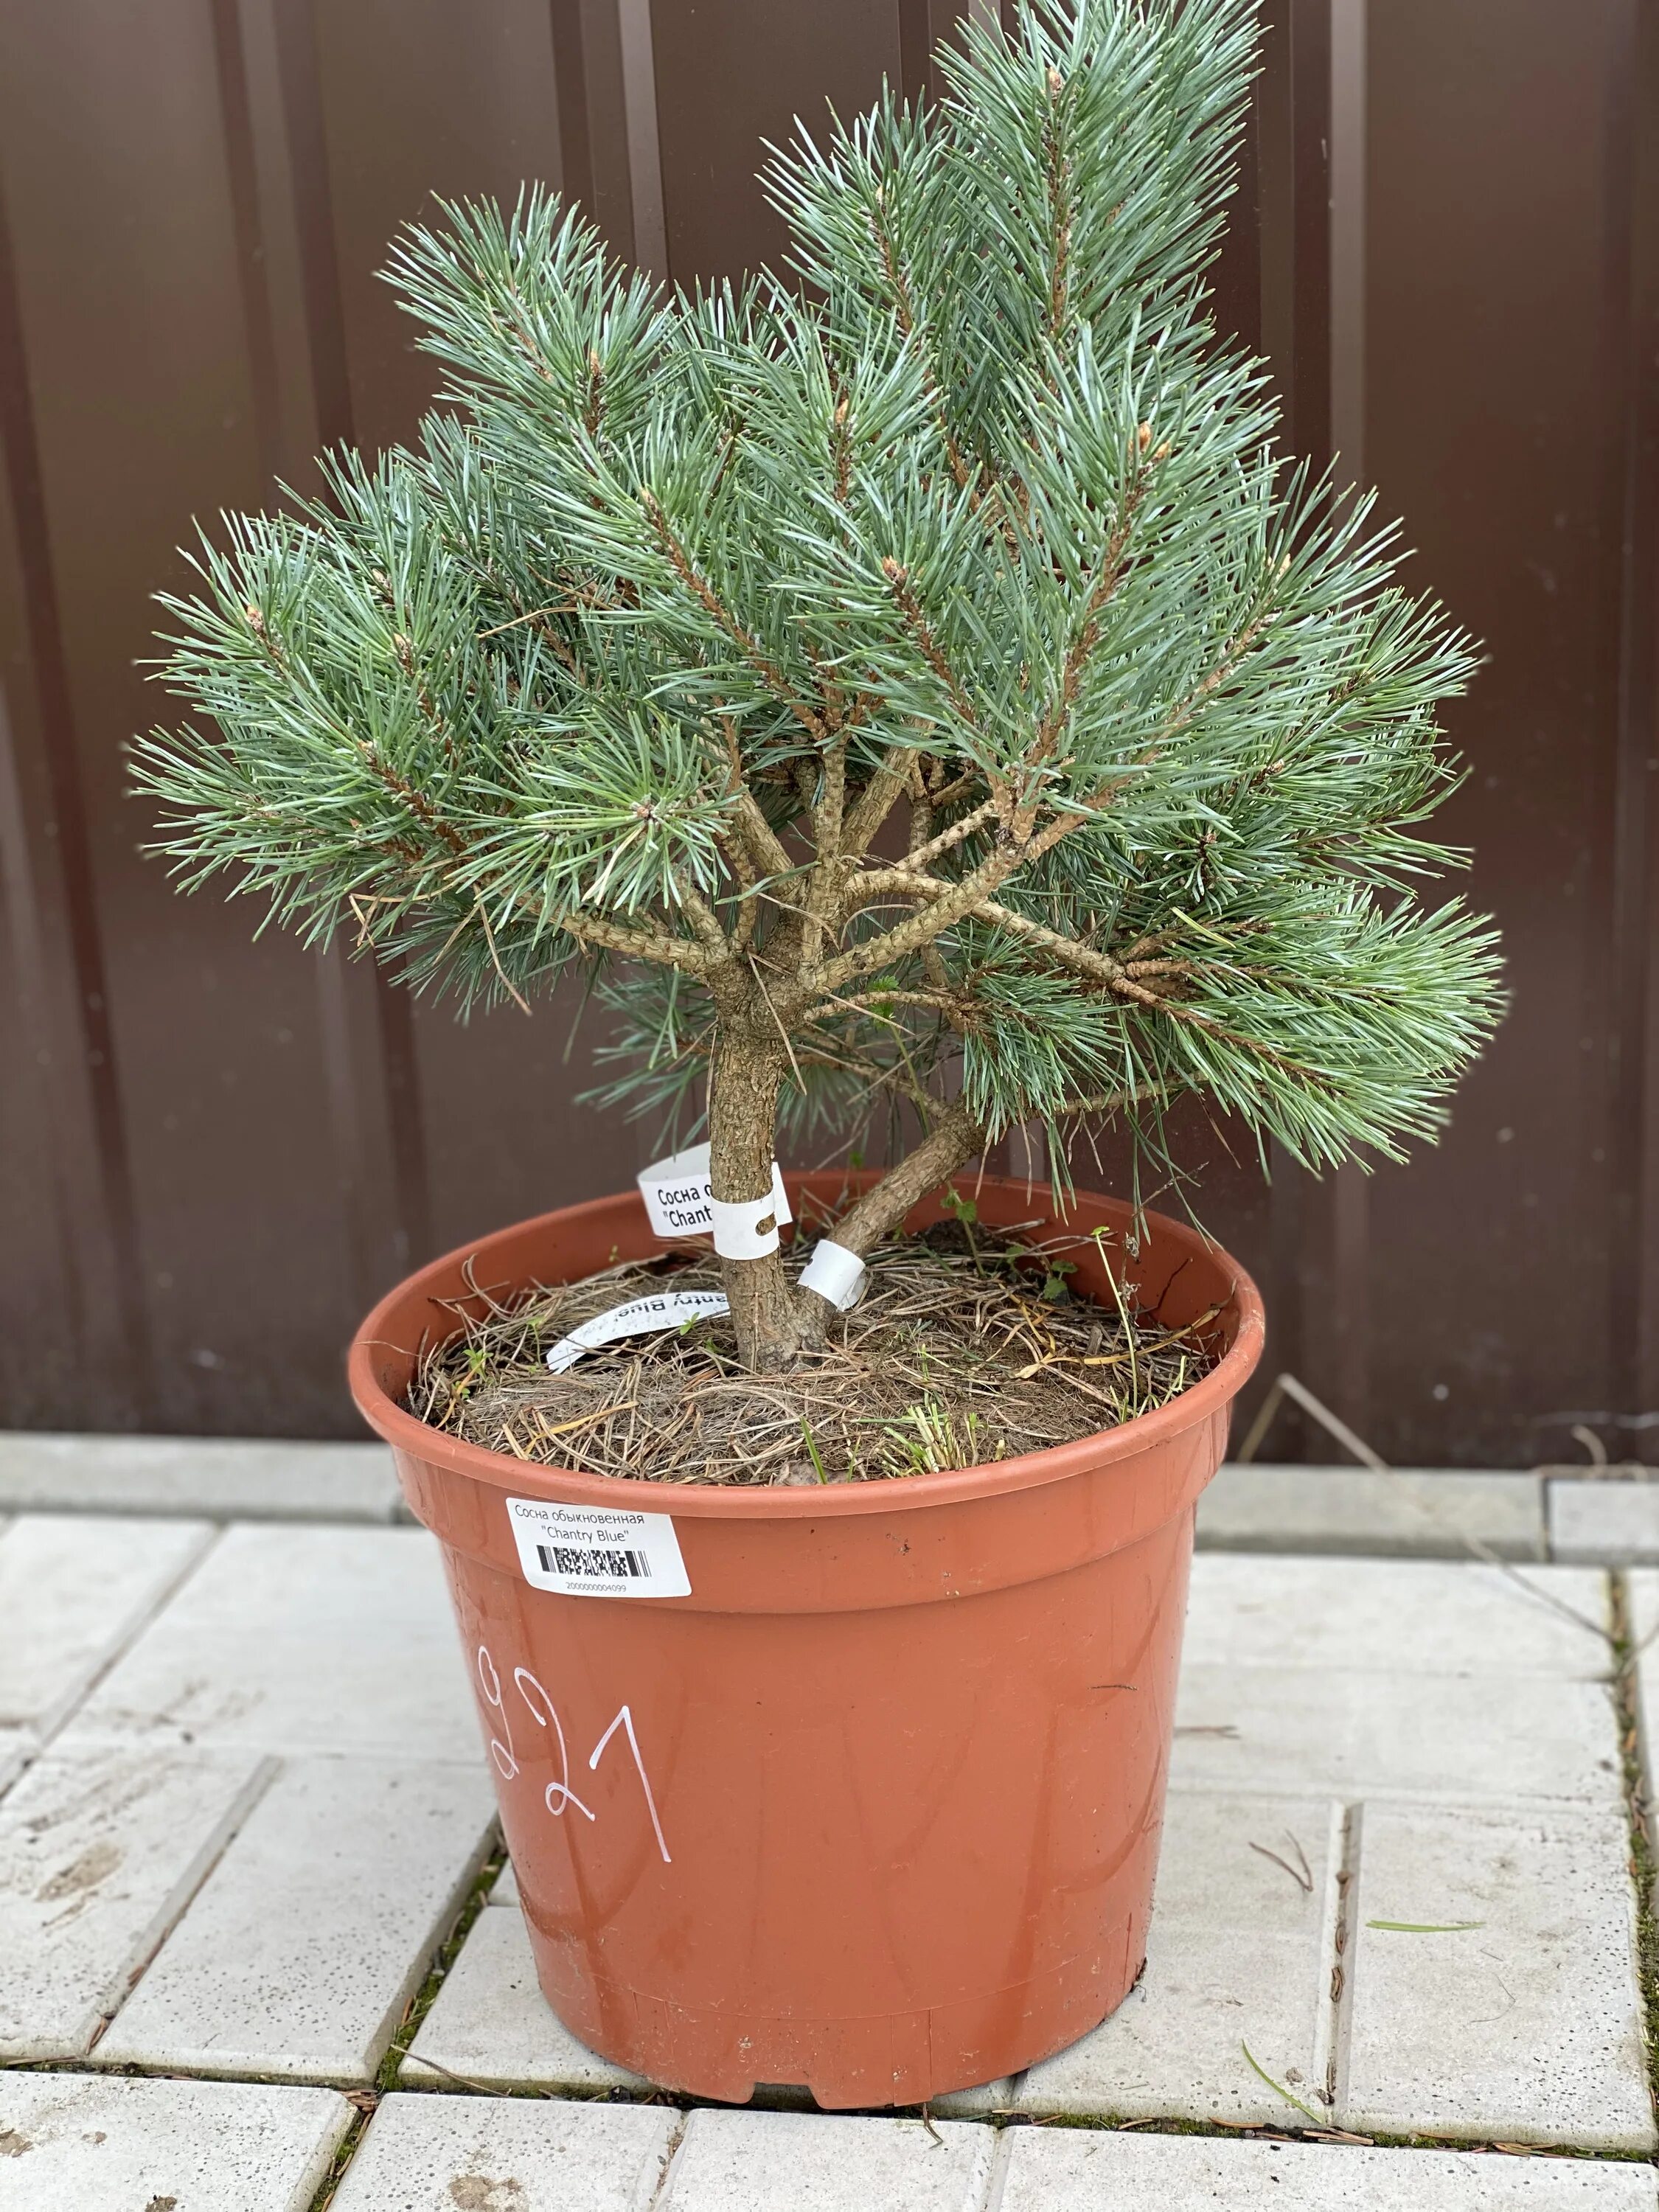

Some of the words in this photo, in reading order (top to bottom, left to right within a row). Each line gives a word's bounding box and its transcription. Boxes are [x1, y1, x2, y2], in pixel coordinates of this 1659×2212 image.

[658, 1187, 700, 1206] Сосна
[663, 1205, 713, 1228] "Chant
[674, 1293, 726, 1306] antry
[515, 1505, 549, 1520] Сосна
[552, 1510, 645, 1524] обыкновенная
[541, 1526, 592, 1543] "Chantry
[597, 1530, 629, 1542] Blue"
[565, 1582, 627, 1593] 2000000004099
